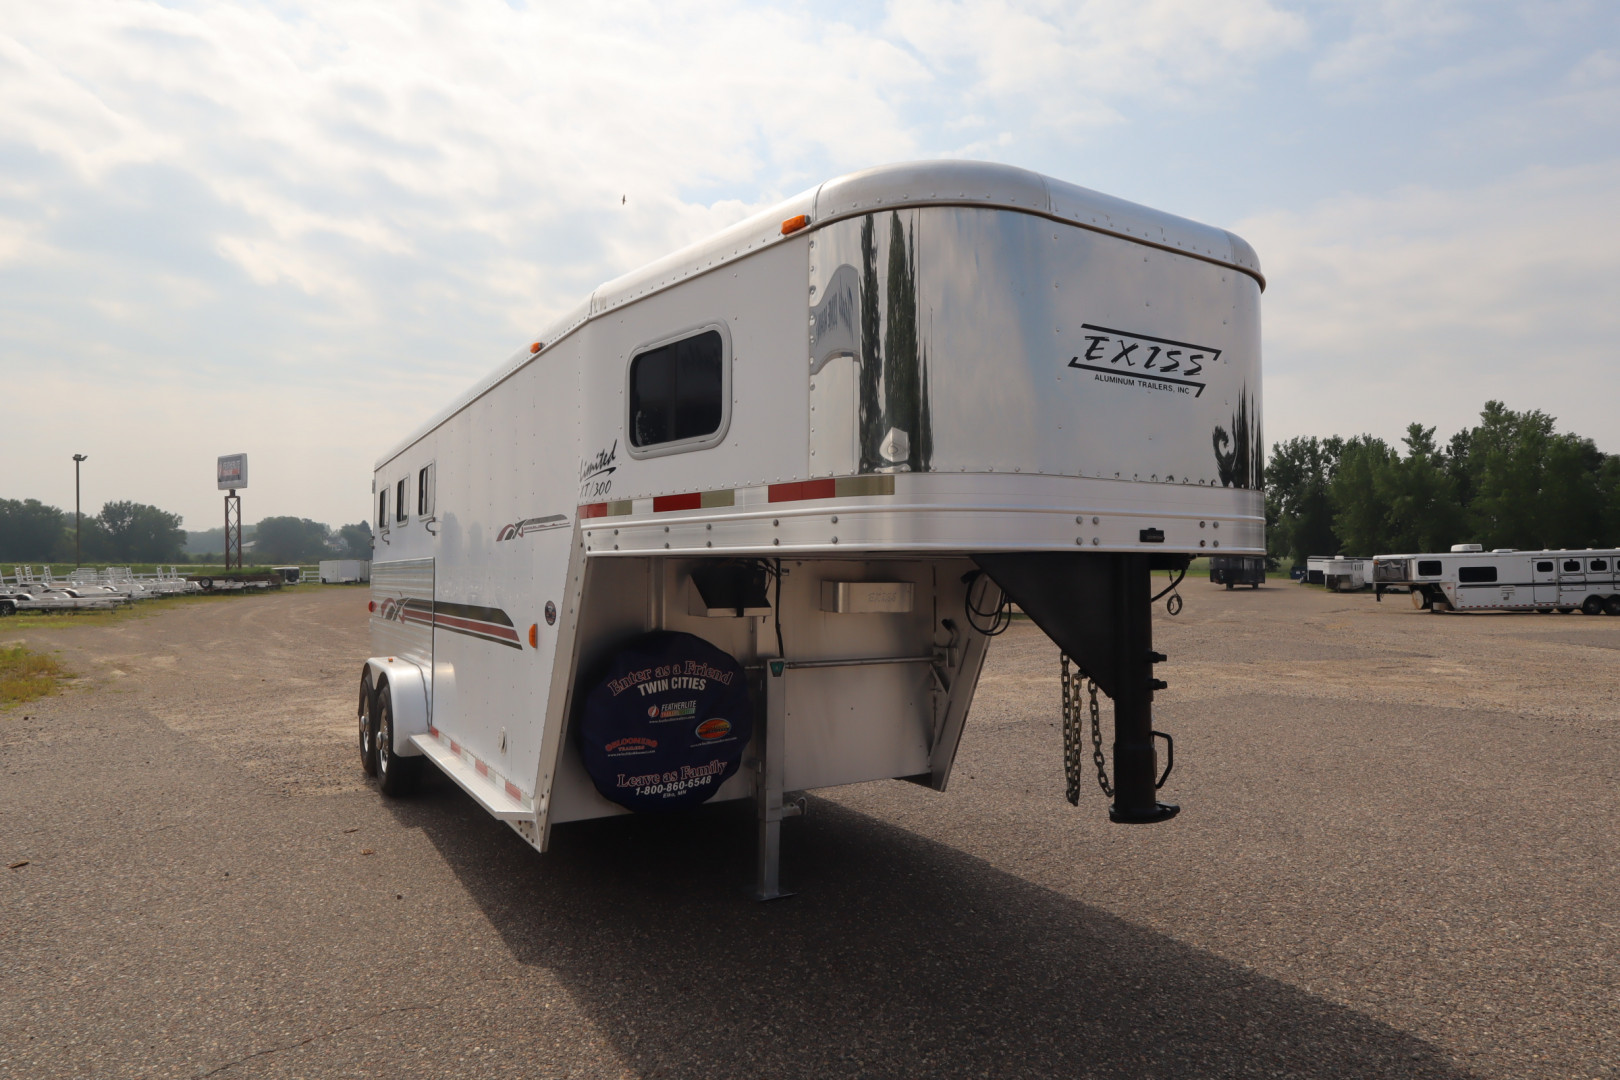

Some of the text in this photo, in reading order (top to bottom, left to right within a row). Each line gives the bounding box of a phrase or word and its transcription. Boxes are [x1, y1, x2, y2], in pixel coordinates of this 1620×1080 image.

[1094, 373, 1135, 387] ALUMINUM
[1138, 380, 1176, 393] TRAILERS,
[579, 438, 618, 483] Limited
[607, 660, 734, 696] Enter as a Friend
[637, 676, 707, 697] TWIN CITIES
[661, 700, 697, 712] FEATHERLITE
[616, 759, 728, 788] Leave as Family
[634, 775, 712, 796] 1-800-860-6548
